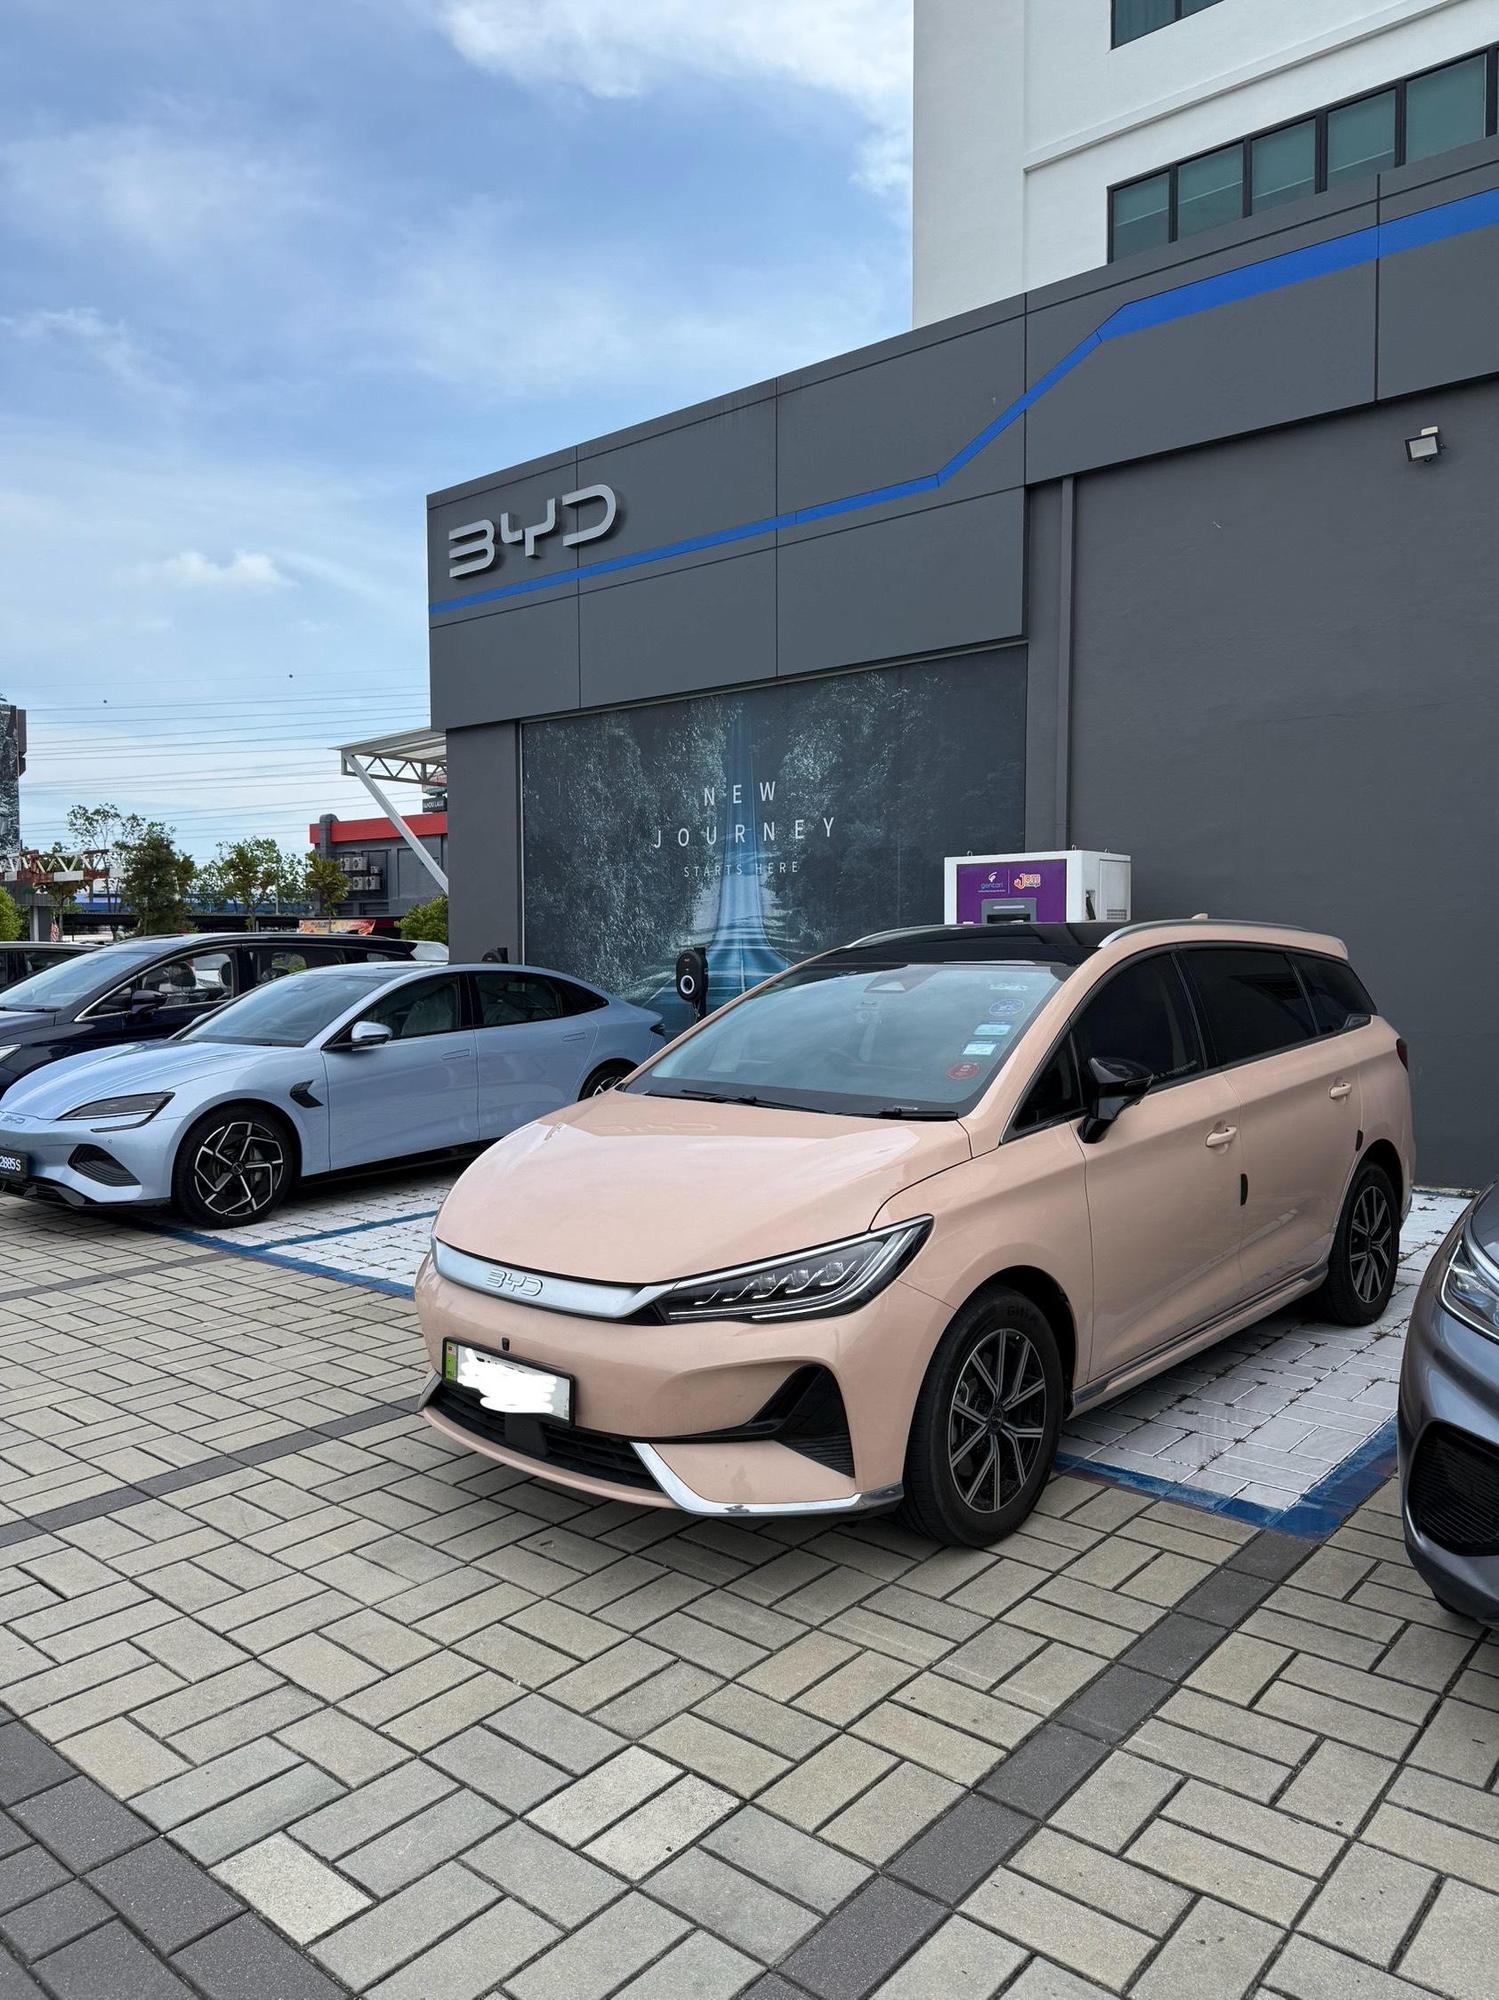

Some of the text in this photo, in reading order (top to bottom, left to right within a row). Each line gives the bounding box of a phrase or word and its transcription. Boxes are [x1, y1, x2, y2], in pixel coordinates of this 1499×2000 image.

[449, 484, 617, 578] BYD
[703, 781, 776, 806] NEW
[653, 816, 835, 849] JOURNEY
[683, 861, 799, 878] STARTS HERE
[487, 1268, 543, 1296] BYD
